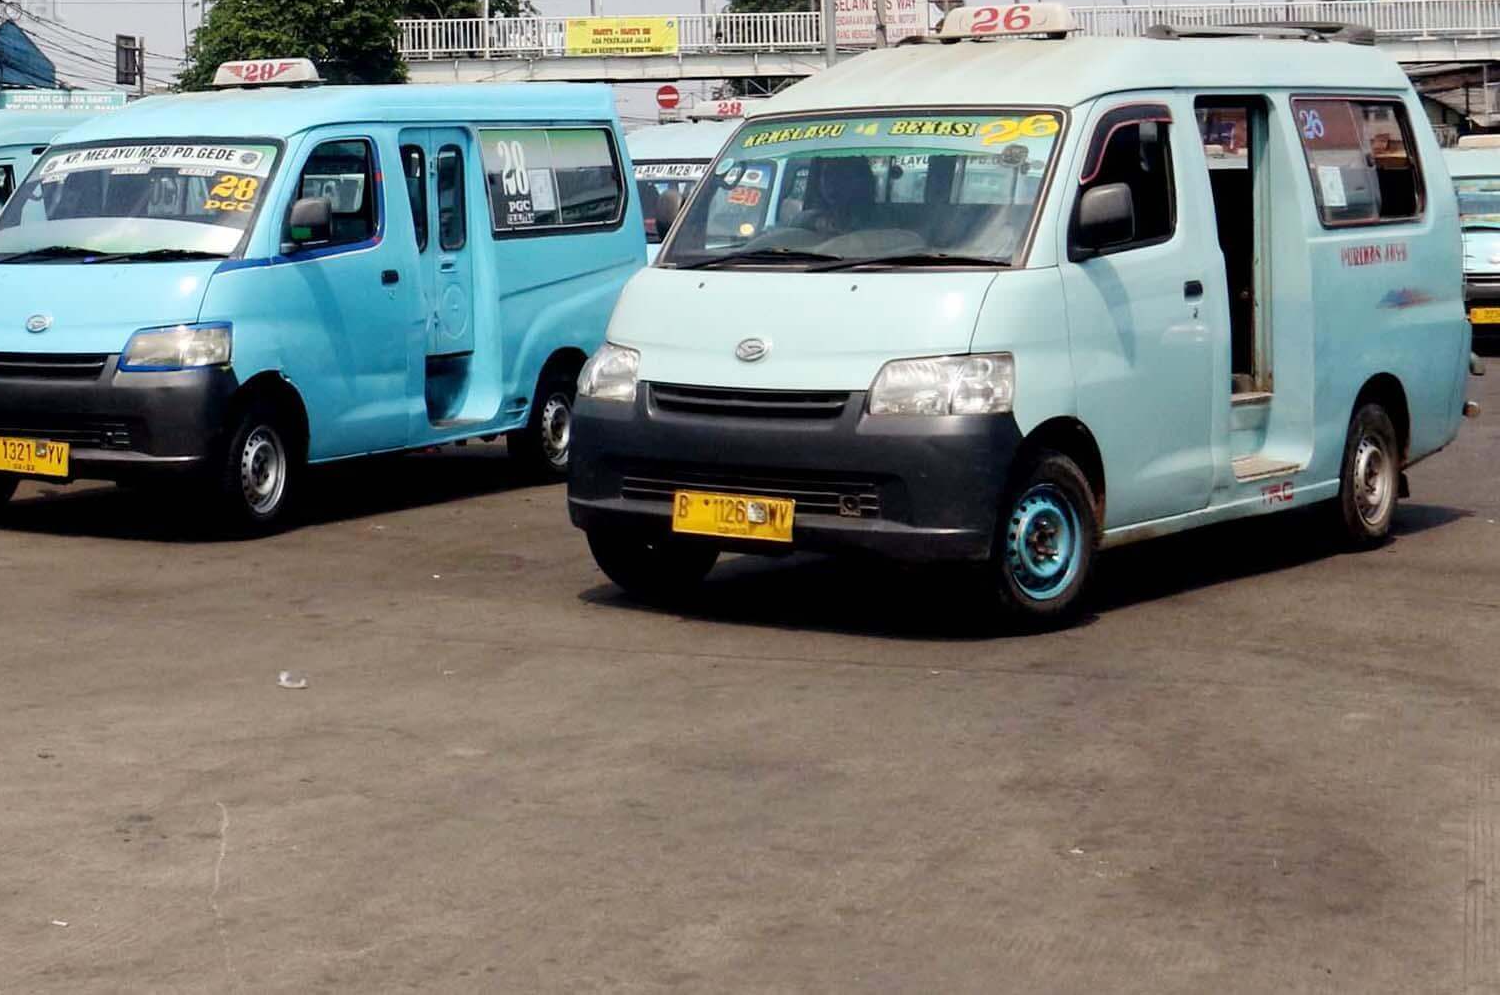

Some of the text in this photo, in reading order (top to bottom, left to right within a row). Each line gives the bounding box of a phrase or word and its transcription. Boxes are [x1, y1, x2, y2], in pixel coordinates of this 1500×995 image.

[971, 5, 1031, 34] 26
[244, 63, 275, 82] 28
[717, 101, 742, 115] 28
[889, 120, 980, 137] BEKASI
[979, 114, 1060, 146] 26
[1300, 109, 1325, 140] 26
[86, 147, 135, 161] MELAYU
[140, 147, 168, 158] M28
[497, 140, 530, 196] 28
[667, 166, 691, 176] M28
[211, 174, 259, 201] 28
[204, 200, 256, 211] PGC
[508, 200, 531, 213] PGC
[2, 439, 32, 462] 1321
[48, 445, 64, 465] YV
[679, 494, 689, 518] B
[713, 499, 746, 524] 1126
